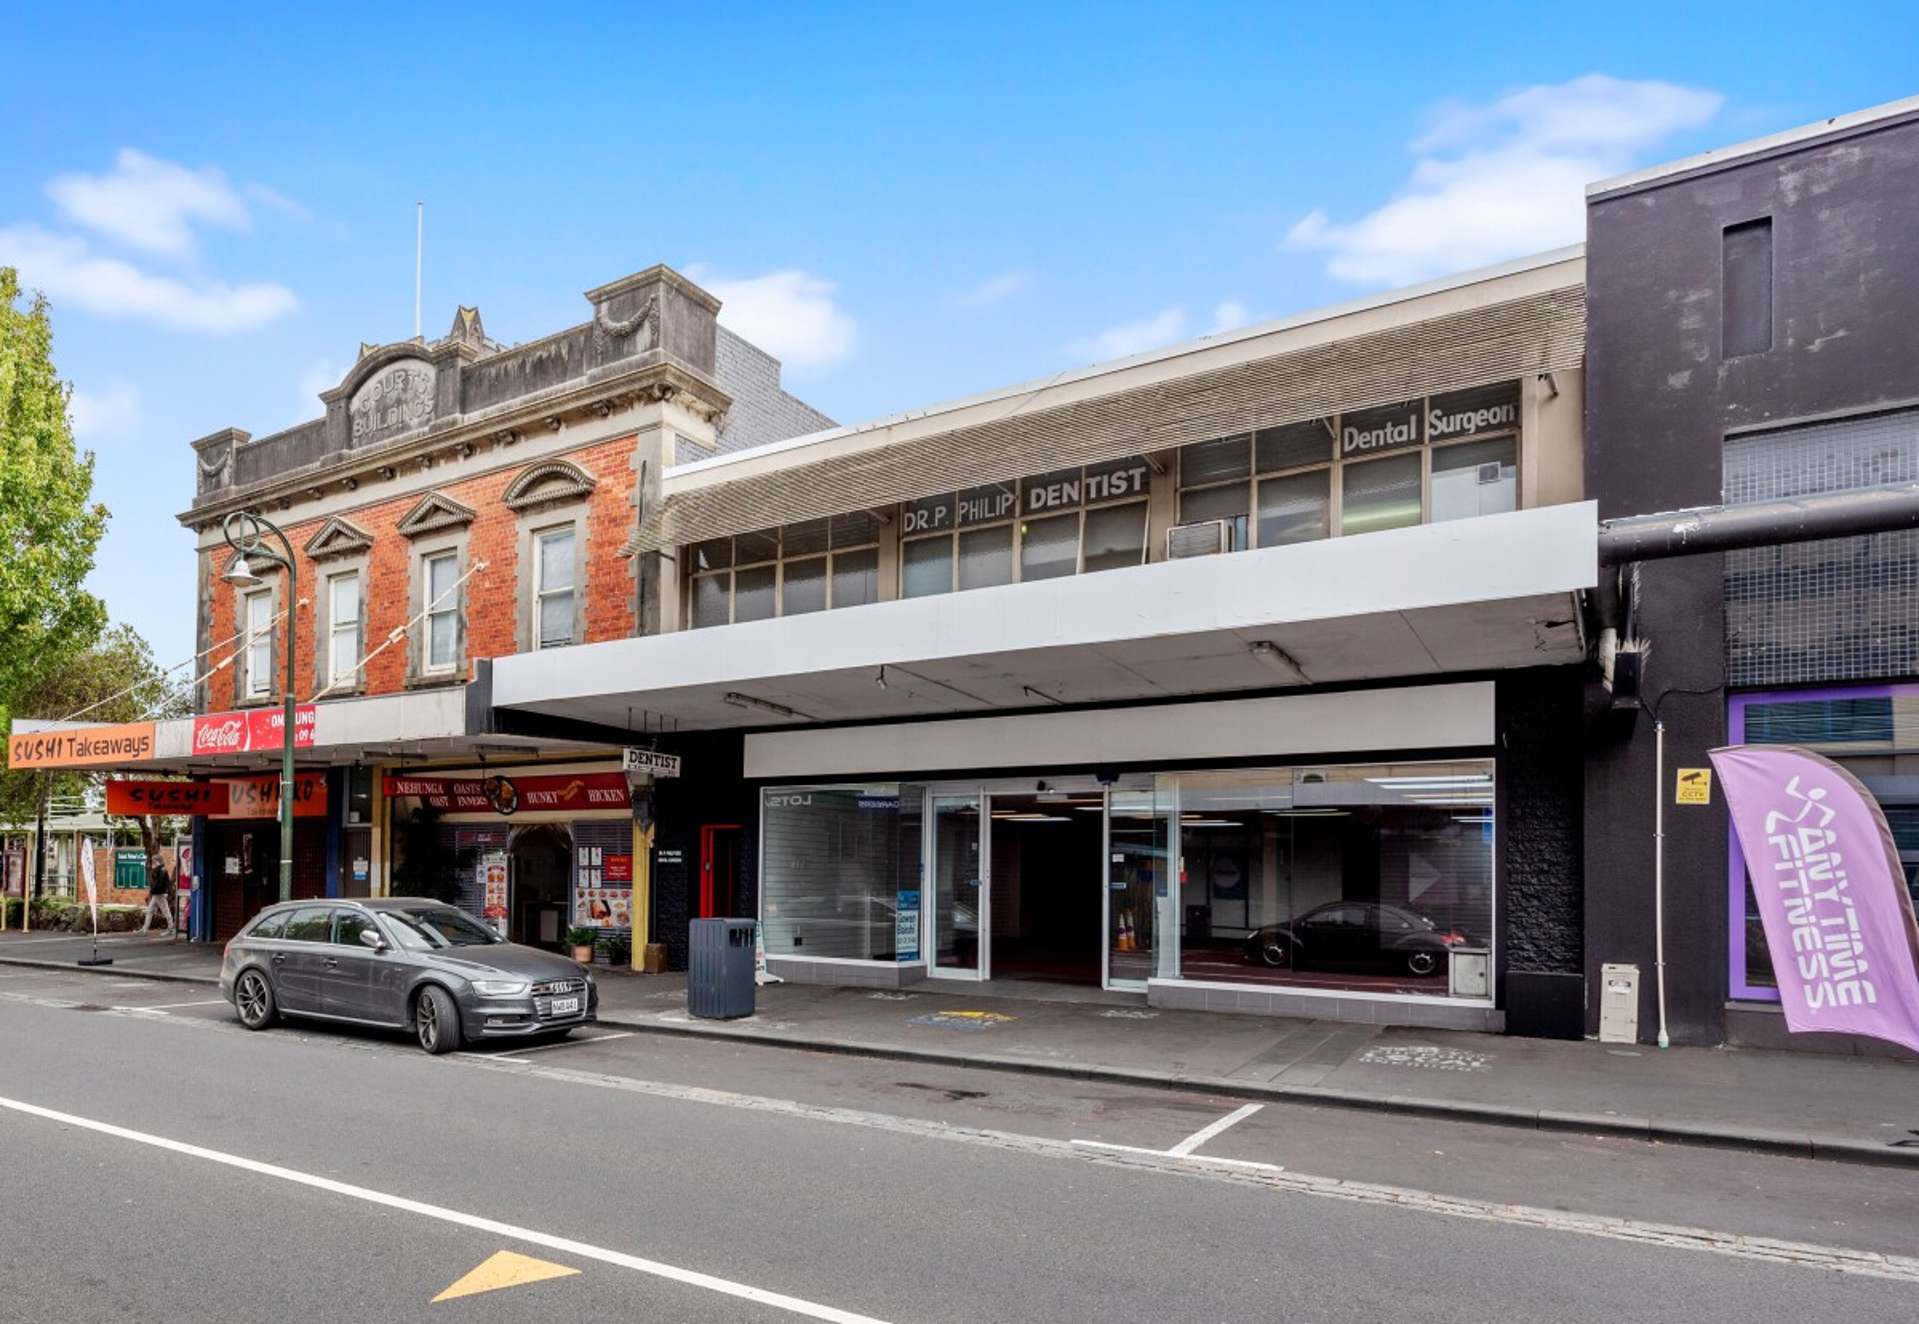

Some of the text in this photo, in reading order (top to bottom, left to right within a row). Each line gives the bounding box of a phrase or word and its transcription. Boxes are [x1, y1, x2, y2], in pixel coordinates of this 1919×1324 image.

[353, 396, 434, 437] BUILDINGS
[1343, 404, 1514, 452] Dental Surgeon
[959, 494, 1015, 522] PHILIP
[1030, 467, 1146, 510] DENTIST
[14, 736, 150, 762] SUSHI Takeaways
[197, 720, 242, 749] Coca-Cola
[629, 751, 678, 769] DENTIST
[128, 783, 214, 801] SUSHI
[231, 781, 280, 804] USHI
[1767, 833, 1838, 1009] FITNESS
[1798, 827, 1876, 1005] ANYTIME
